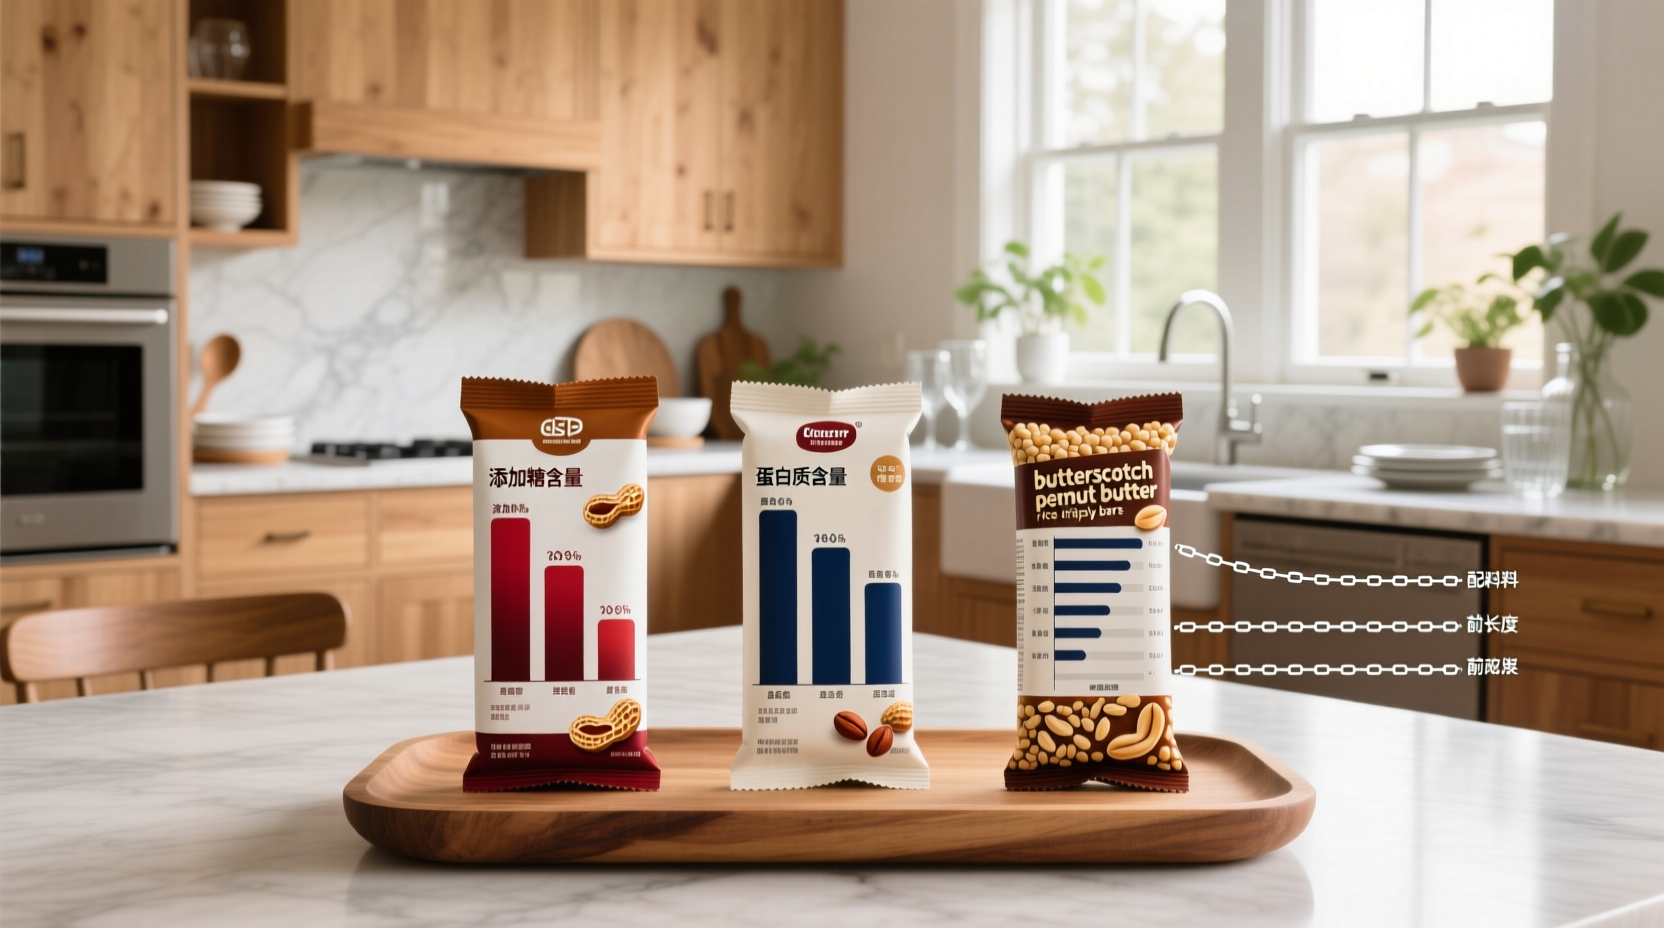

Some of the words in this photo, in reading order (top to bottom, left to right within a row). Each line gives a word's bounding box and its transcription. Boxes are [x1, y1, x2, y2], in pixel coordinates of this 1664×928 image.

[489, 466, 583, 488] 添加糖含量
[756, 466, 847, 486] 蛋白质含量
[1034, 460, 1153, 490] butterscotch
[1100, 482, 1158, 503] butter
